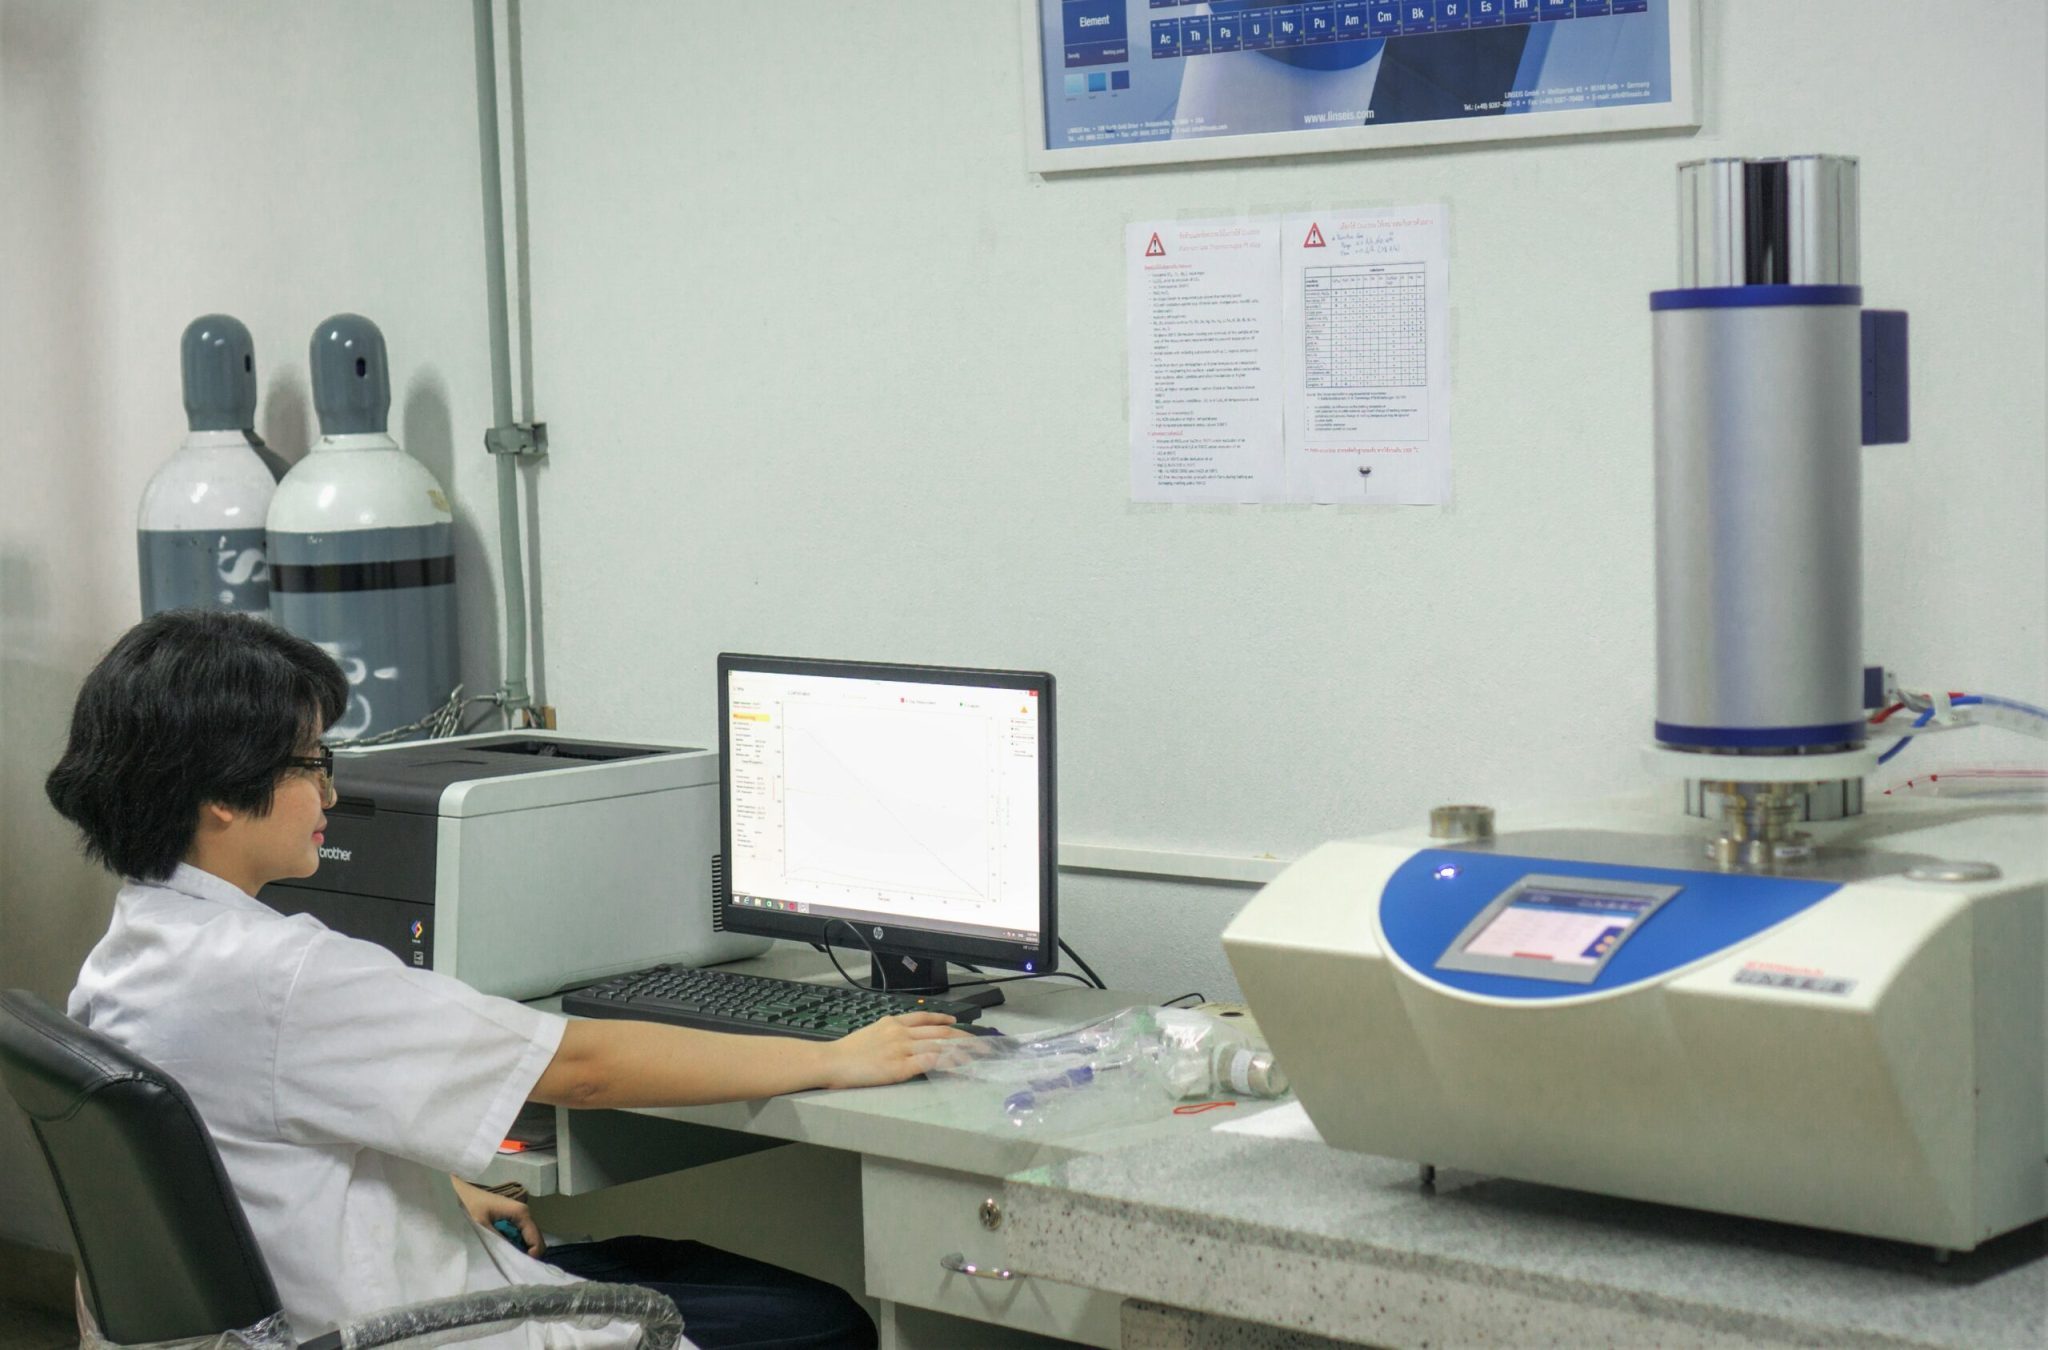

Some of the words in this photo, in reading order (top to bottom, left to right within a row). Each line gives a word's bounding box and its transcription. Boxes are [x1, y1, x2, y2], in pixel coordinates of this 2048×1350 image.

[1079, 14, 1110, 27] Element
[1160, 34, 1171, 44] Ac
[1190, 30, 1201, 41] Th
[1220, 27, 1231, 38] Pa
[1253, 24, 1260, 35] U
[1282, 21, 1294, 34] Np
[1314, 18, 1325, 29] Pu
[1345, 15, 1359, 26] Am
[1378, 11, 1392, 23] Cm
[1412, 8, 1424, 19] Bk
[1447, 4, 1457, 15] Cf
[1481, 1, 1492, 13] Es
[1304, 110, 1374, 123] www.linseis.com
